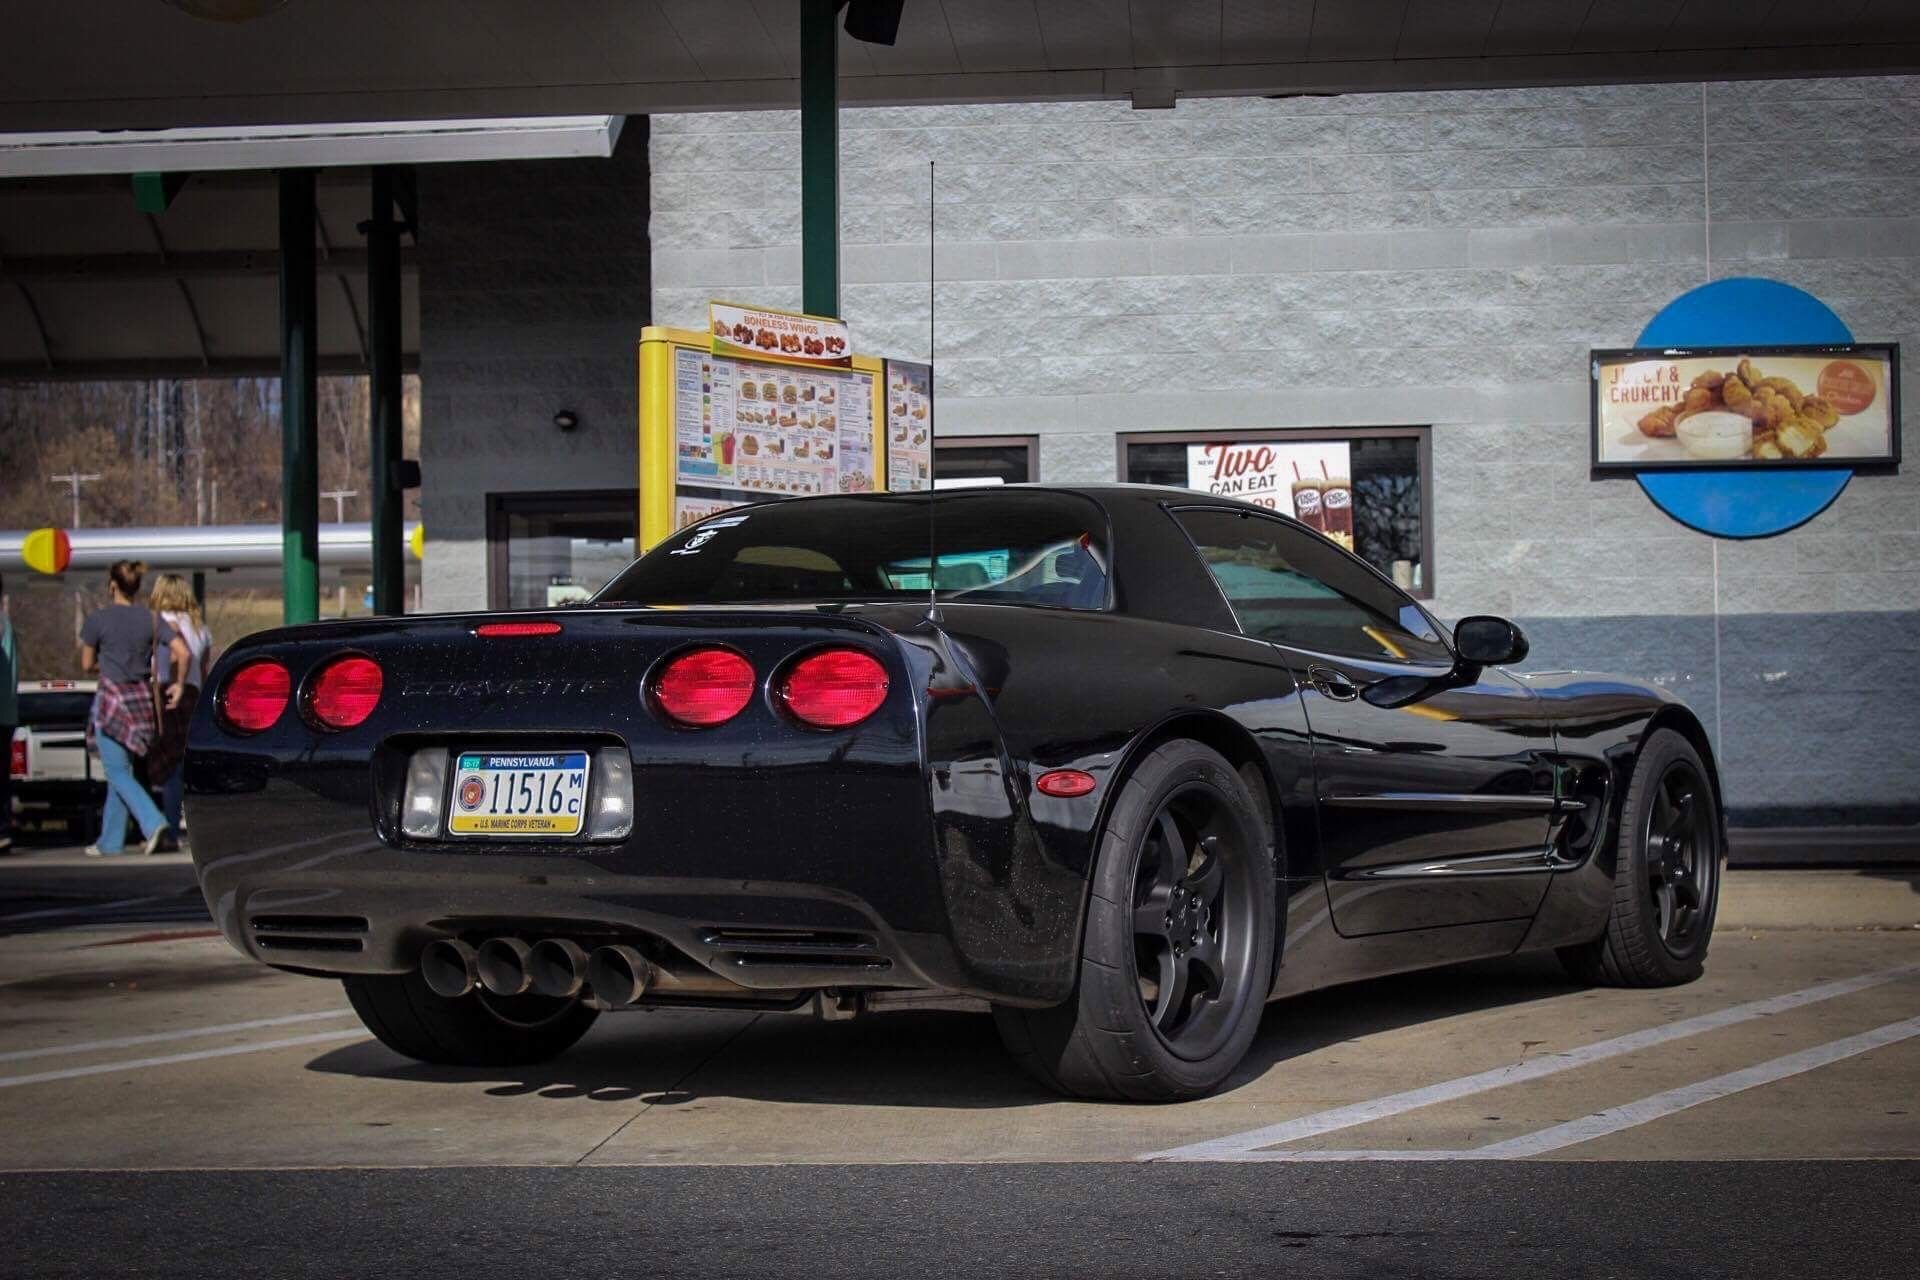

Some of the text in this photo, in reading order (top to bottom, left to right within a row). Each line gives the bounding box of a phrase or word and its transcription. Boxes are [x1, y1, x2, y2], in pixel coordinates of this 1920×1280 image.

[744, 315, 789, 330] BONELESS
[789, 321, 818, 335] WINGS
[1669, 366, 1679, 383] &
[1610, 385, 1680, 402] CRUNCHY
[1204, 441, 1277, 480] Two
[1209, 474, 1277, 496] CAN EAT
[489, 757, 555, 767] PENNSYLVANIA
[489, 772, 583, 814] 11516 M C
[490, 820, 510, 829] MARINE
[511, 820, 528, 829] CORPS
[528, 820, 552, 829] VETERAN
